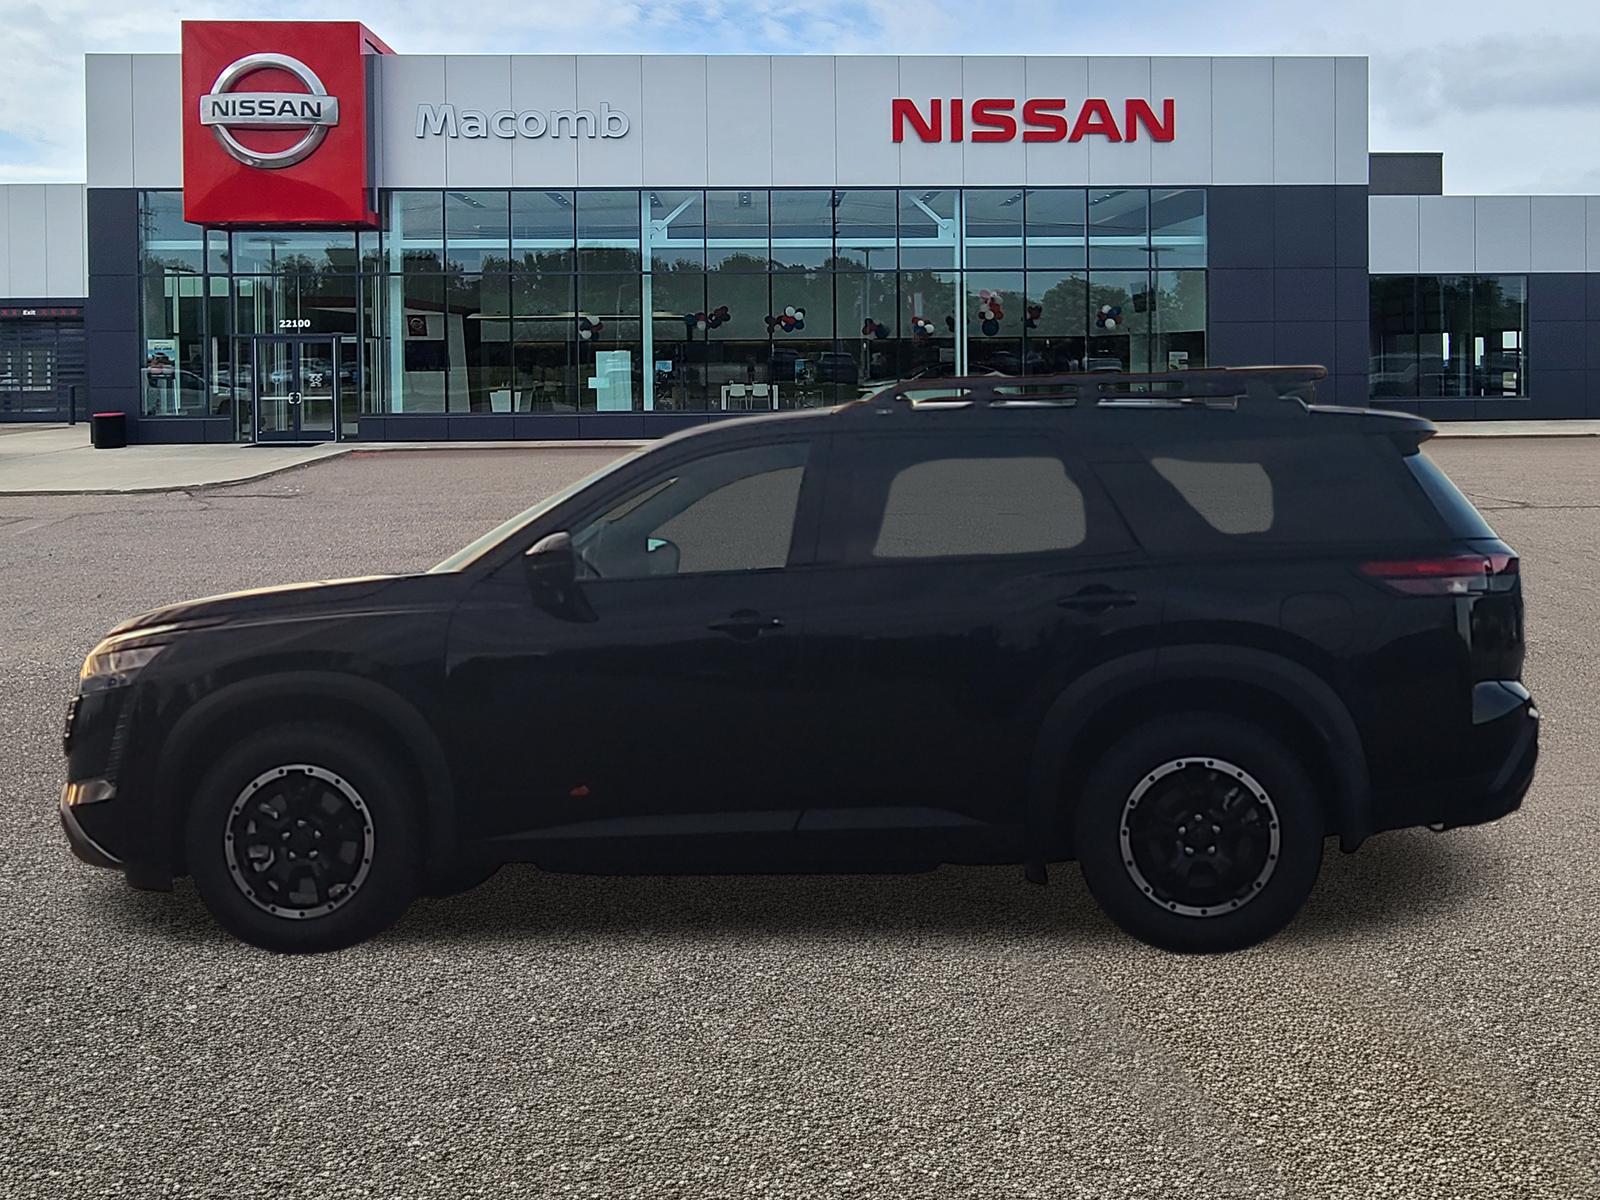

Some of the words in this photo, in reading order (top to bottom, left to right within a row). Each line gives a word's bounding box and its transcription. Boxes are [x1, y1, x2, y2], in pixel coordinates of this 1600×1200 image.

[211, 99, 322, 118] NISSAN
[415, 101, 630, 139] Macomb
[891, 98, 1176, 143] NISSAN
[279, 319, 311, 328] 22100
